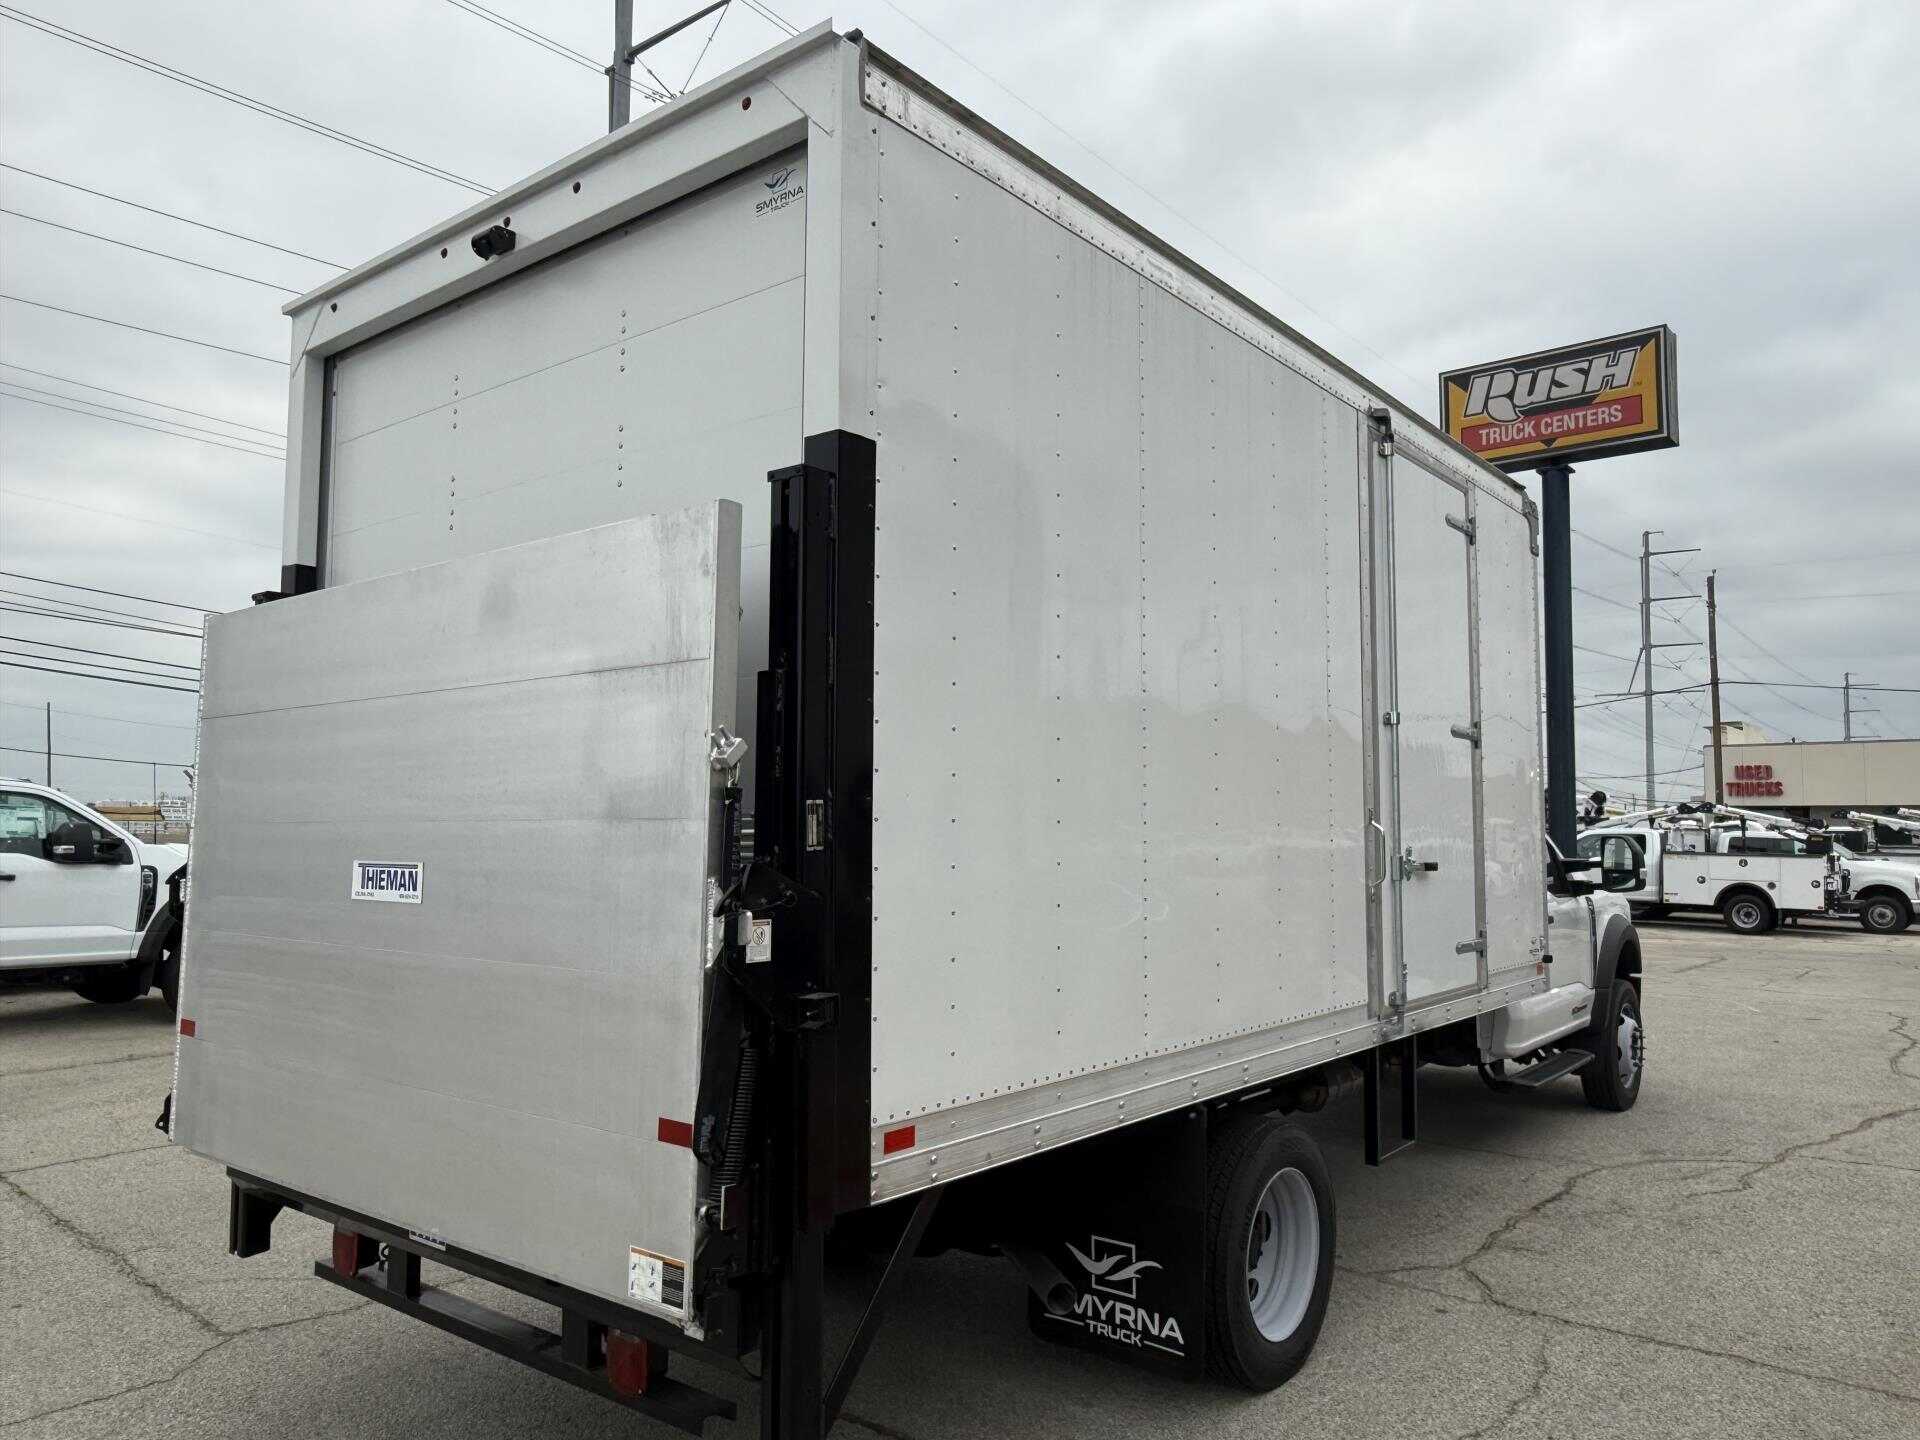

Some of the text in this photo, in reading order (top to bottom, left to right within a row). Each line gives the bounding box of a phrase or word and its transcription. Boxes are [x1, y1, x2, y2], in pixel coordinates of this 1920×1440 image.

[755, 185, 804, 213] SMYRNA
[1463, 346, 1641, 425] RUSH
[1479, 404, 1622, 446] TRUCK CENTERS
[1734, 764, 1773, 780] USED
[1726, 781, 1784, 797] TRUCKS
[357, 862, 418, 891] THIEMAN
[1073, 1293, 1185, 1345] MYRNA
[1085, 1319, 1142, 1347] TRUCK
